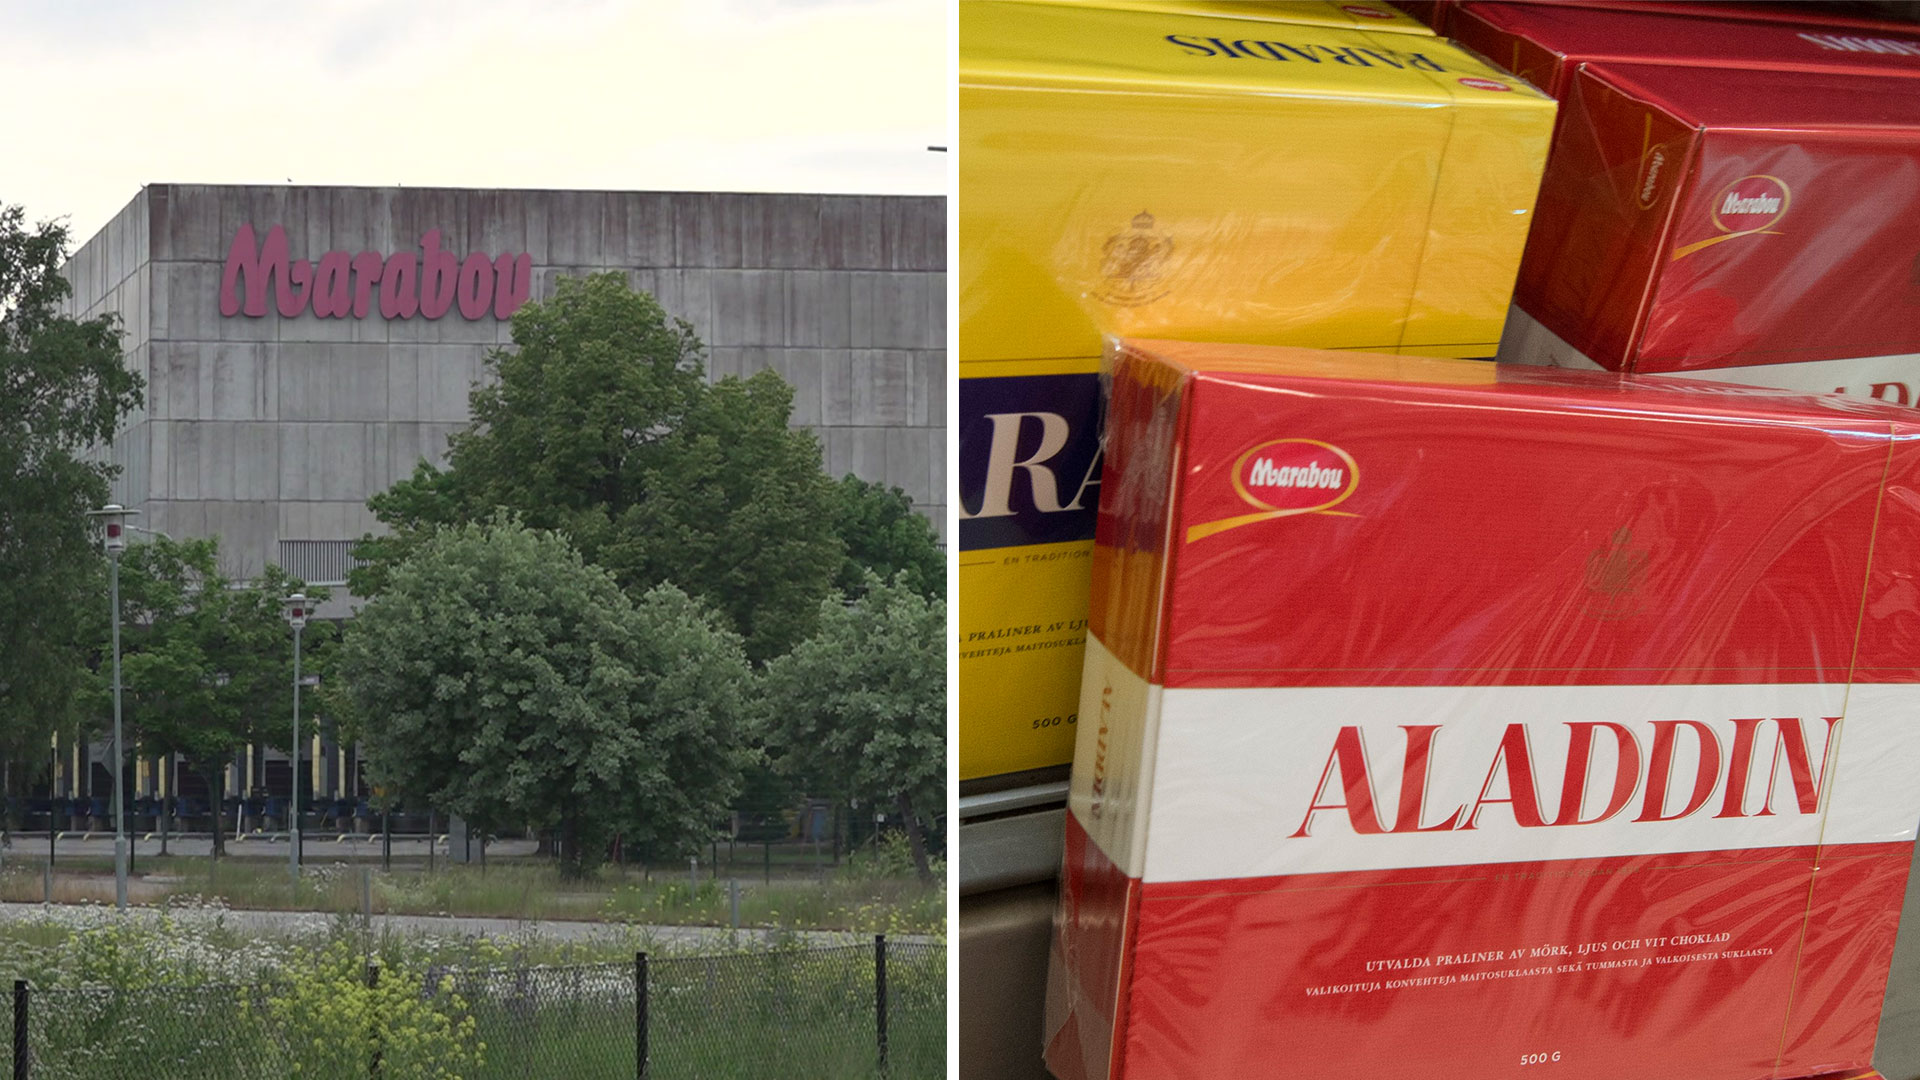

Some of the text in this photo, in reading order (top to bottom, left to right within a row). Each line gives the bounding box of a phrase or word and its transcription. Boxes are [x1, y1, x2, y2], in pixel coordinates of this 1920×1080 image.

[1165, 34, 1448, 73] PARADIS
[1720, 191, 1782, 215] Marabou
[220, 222, 532, 321] Marabou
[1250, 457, 1343, 490] Marabou
[1024, 550, 1091, 564] TRADITION
[968, 625, 1042, 642] PRALINER
[1046, 622, 1065, 633] AV
[959, 646, 1012, 659] VEHTEJA
[1032, 714, 1078, 730] 500 G
[1286, 716, 1844, 839] ALADDIN
[1366, 932, 1731, 972] UTVALDA PRALINER AV MÖRK, LJUS OCH VIT CHOKLAD
[1305, 947, 1774, 997] VALIKOITUJA KONVEHTEJA MAITOSUKLAASTA SEKÄ TUMMASTA JA VALKOISESTA SUKLAASTA
[1520, 1050, 1561, 1066] 500 G
